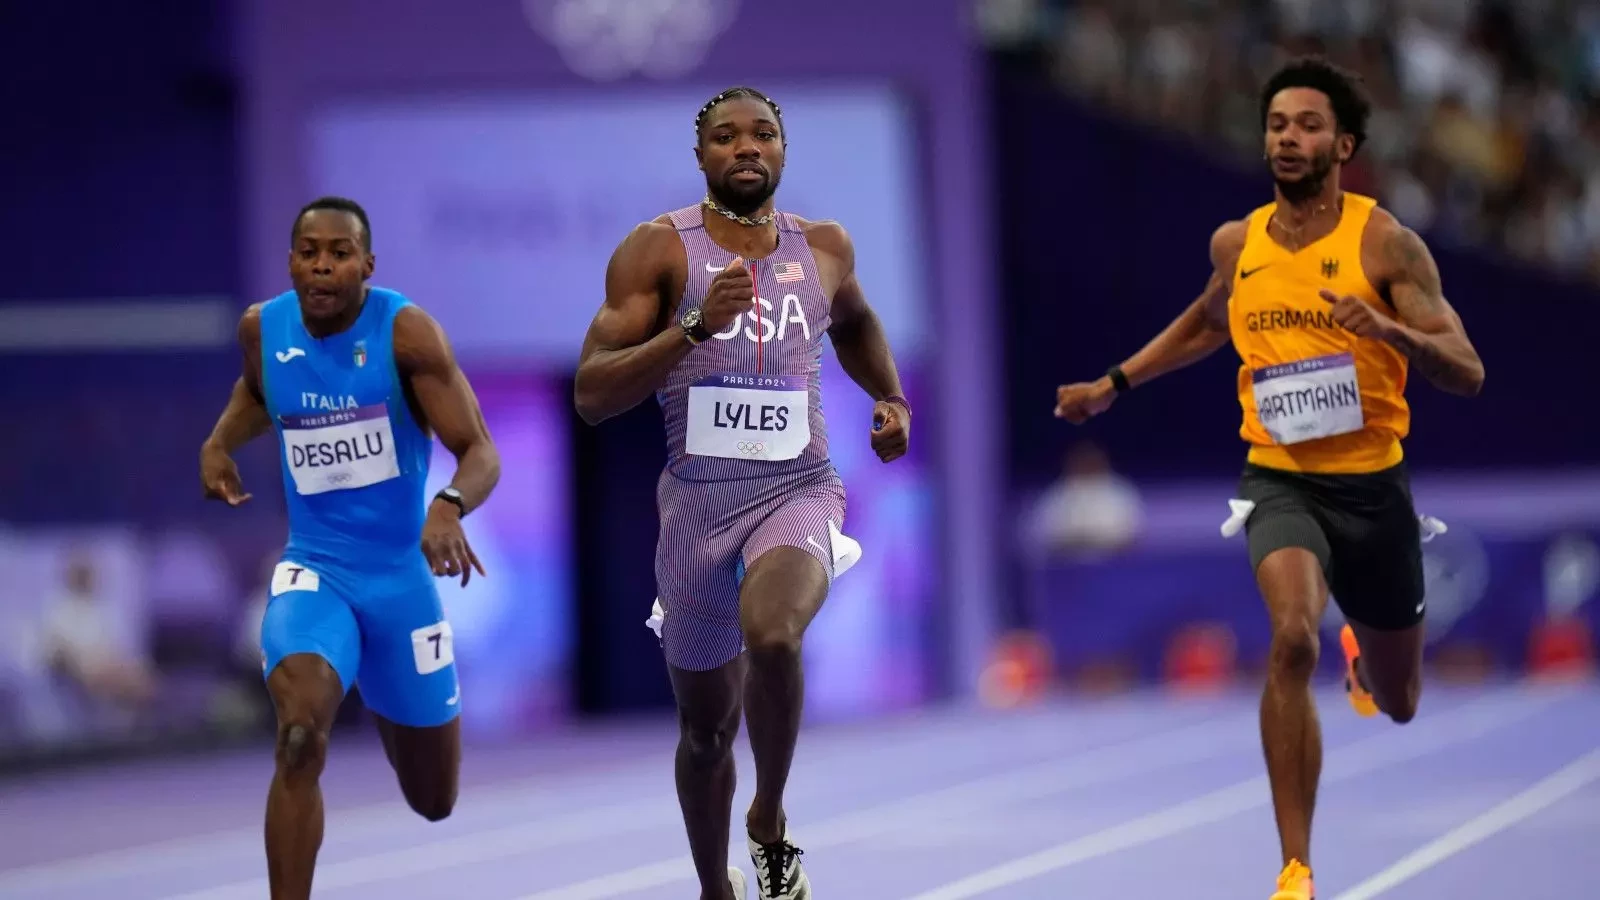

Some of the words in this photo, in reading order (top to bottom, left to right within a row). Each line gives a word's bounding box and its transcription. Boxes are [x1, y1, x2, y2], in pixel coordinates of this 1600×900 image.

[1246, 309, 1336, 332] GERMAN
[723, 375, 754, 385] PARIS
[758, 378, 786, 387] 2024
[301, 391, 359, 411] ITALIA
[714, 401, 789, 432] LYLES
[291, 431, 383, 468] DESALU
[287, 568, 304, 585] 7
[427, 632, 442, 660] 7
